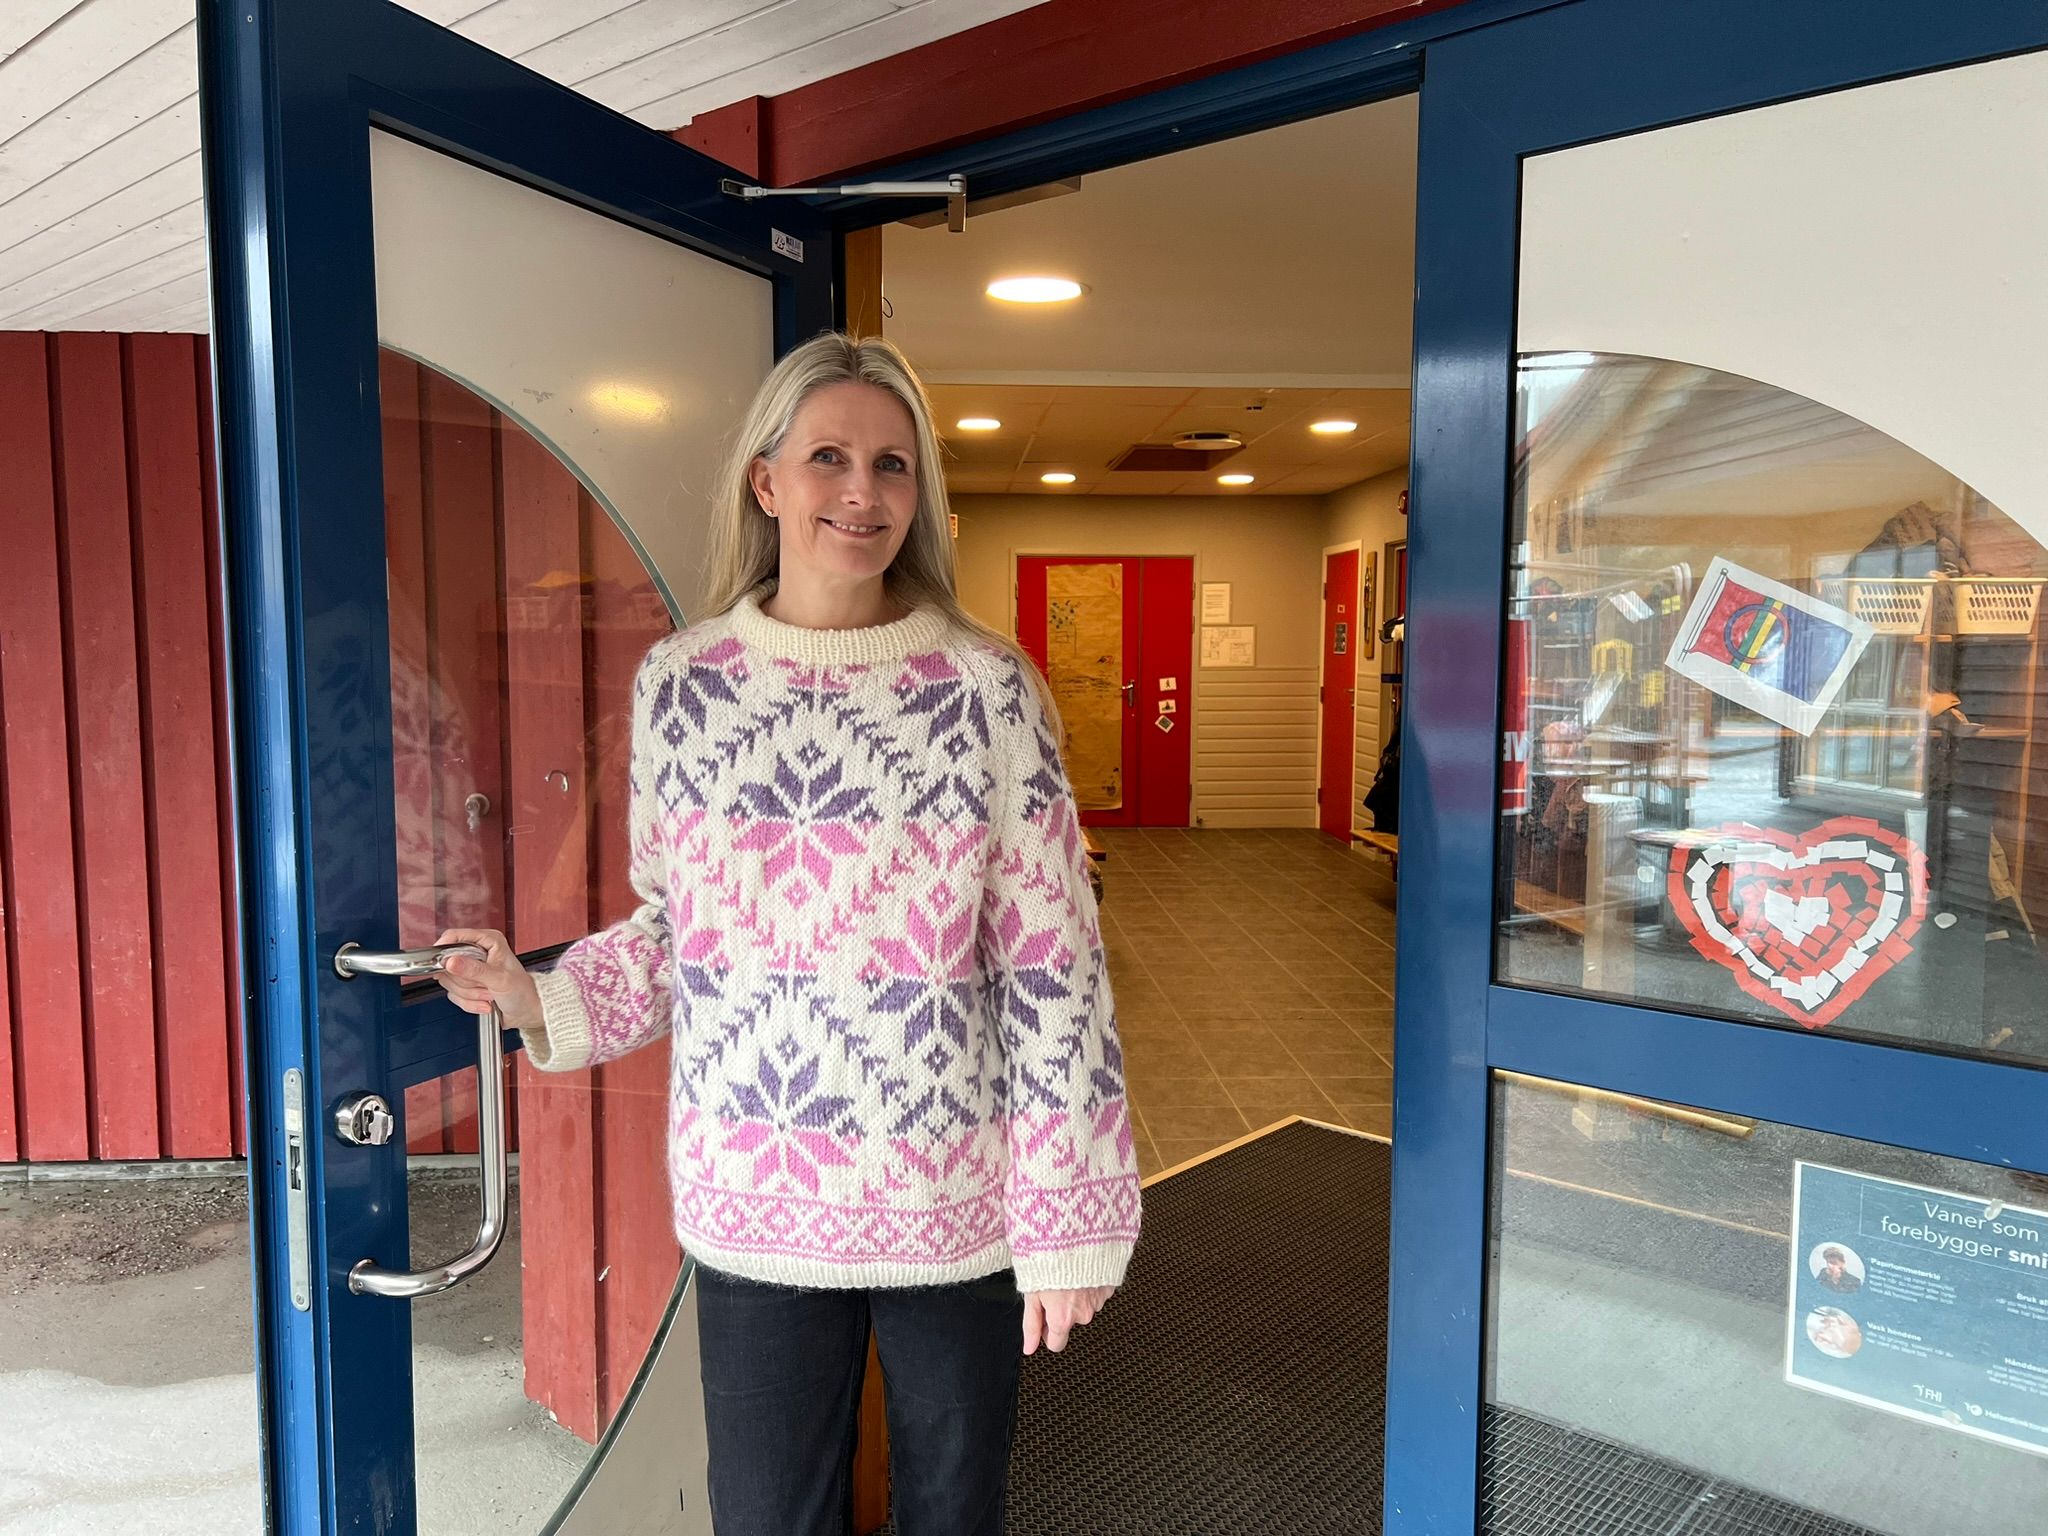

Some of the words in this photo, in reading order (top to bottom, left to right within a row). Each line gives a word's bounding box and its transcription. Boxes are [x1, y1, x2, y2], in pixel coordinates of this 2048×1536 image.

[1881, 1215, 2003, 1257] forebygger
[2008, 1249, 2048, 1269] smi
[1923, 1200, 1986, 1229] Vaner
[1992, 1221, 2039, 1243] som
